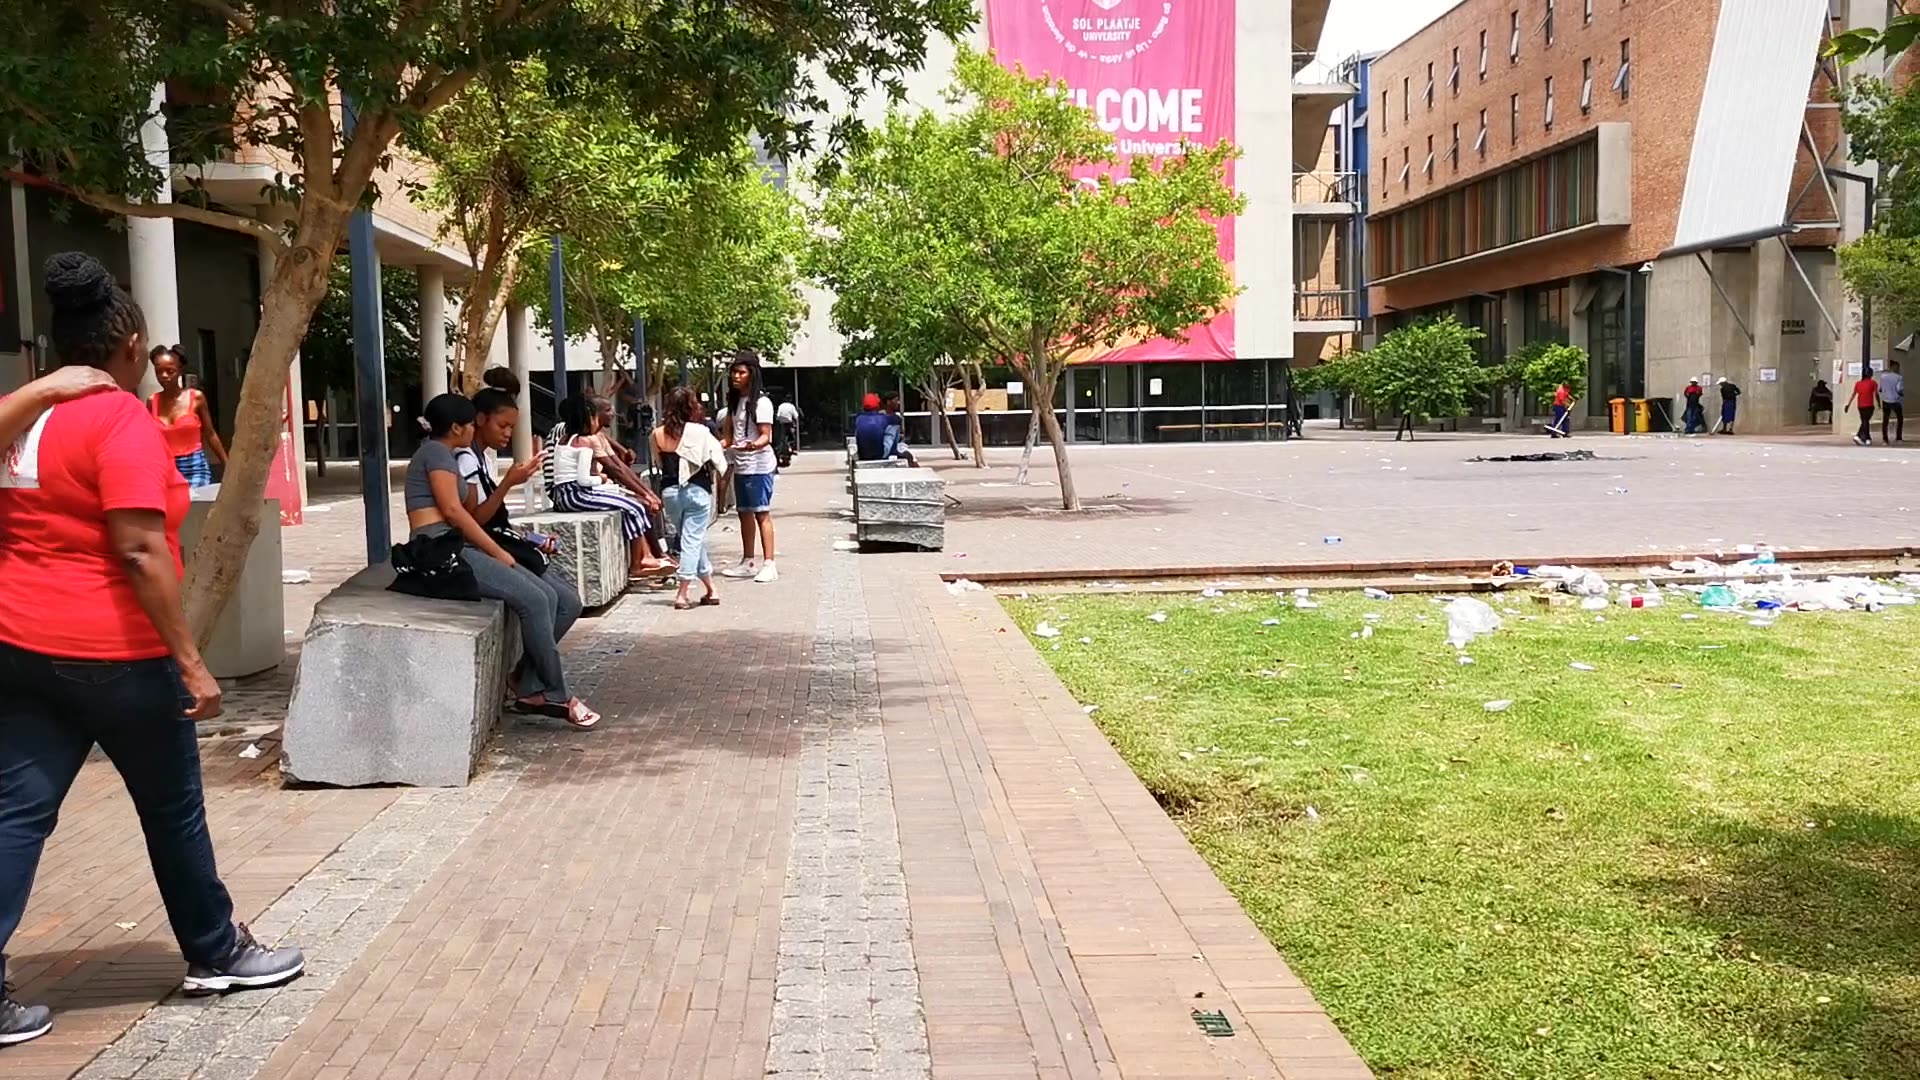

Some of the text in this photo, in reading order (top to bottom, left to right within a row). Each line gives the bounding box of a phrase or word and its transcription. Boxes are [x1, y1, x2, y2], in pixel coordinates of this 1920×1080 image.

[1072, 17, 1141, 30] SOL PLAATJE
[1082, 30, 1131, 42] UNIVERSITY
